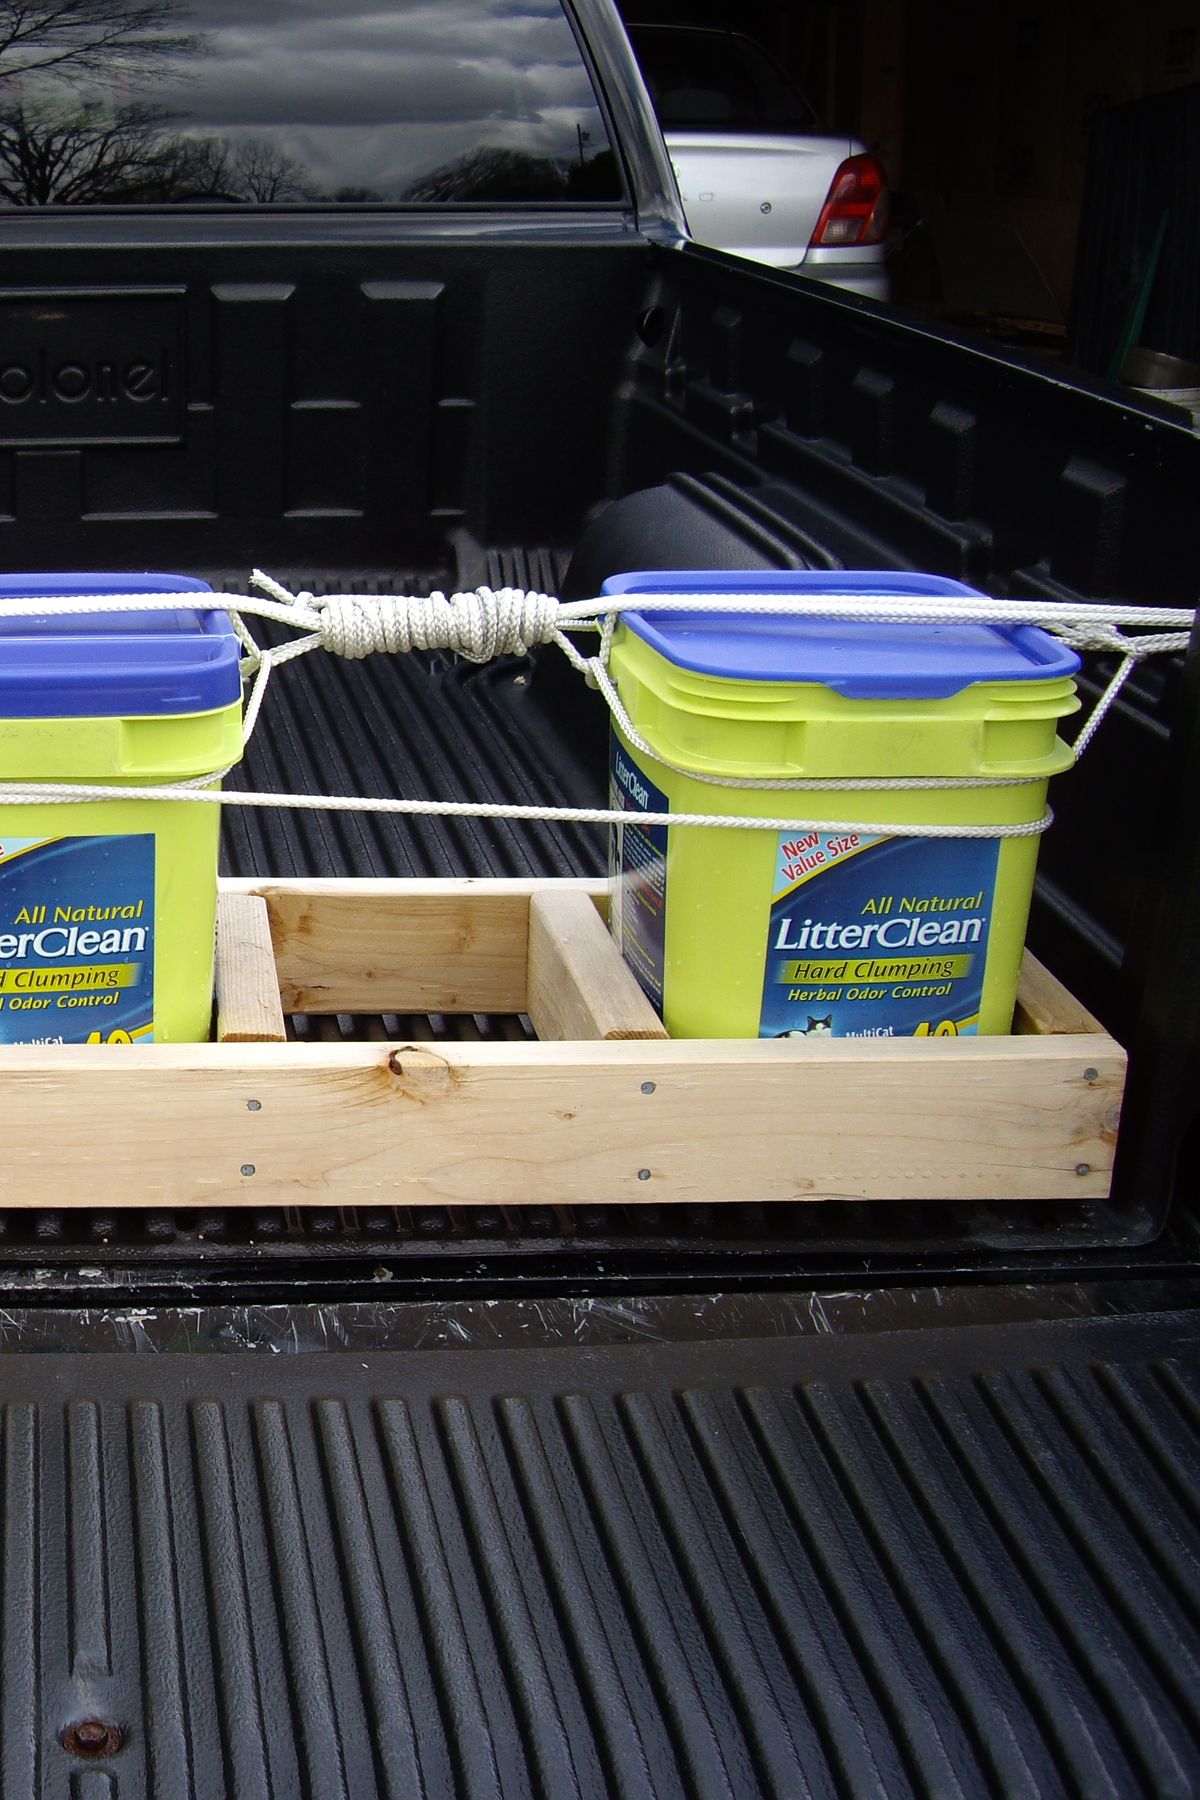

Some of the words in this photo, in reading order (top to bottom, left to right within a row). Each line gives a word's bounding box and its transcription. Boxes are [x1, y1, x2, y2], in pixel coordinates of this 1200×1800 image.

[781, 831, 819, 861] New
[781, 851, 826, 881] Value
[826, 833, 860, 858] Size
[14, 905, 46, 925] All
[53, 899, 144, 923] Natural
[860, 896, 894, 915] All
[898, 891, 984, 914] Natural
[774, 917, 983, 950] LitterClean
[14, 967, 120, 989] Clumping
[793, 961, 849, 979] Hard
[853, 958, 955, 980] Clumping
[9, 995, 52, 1010] Odor
[57, 991, 120, 1009] Control
[787, 988, 843, 1001] Herbal
[846, 986, 887, 1000] Odor
[891, 982, 953, 999] Control
